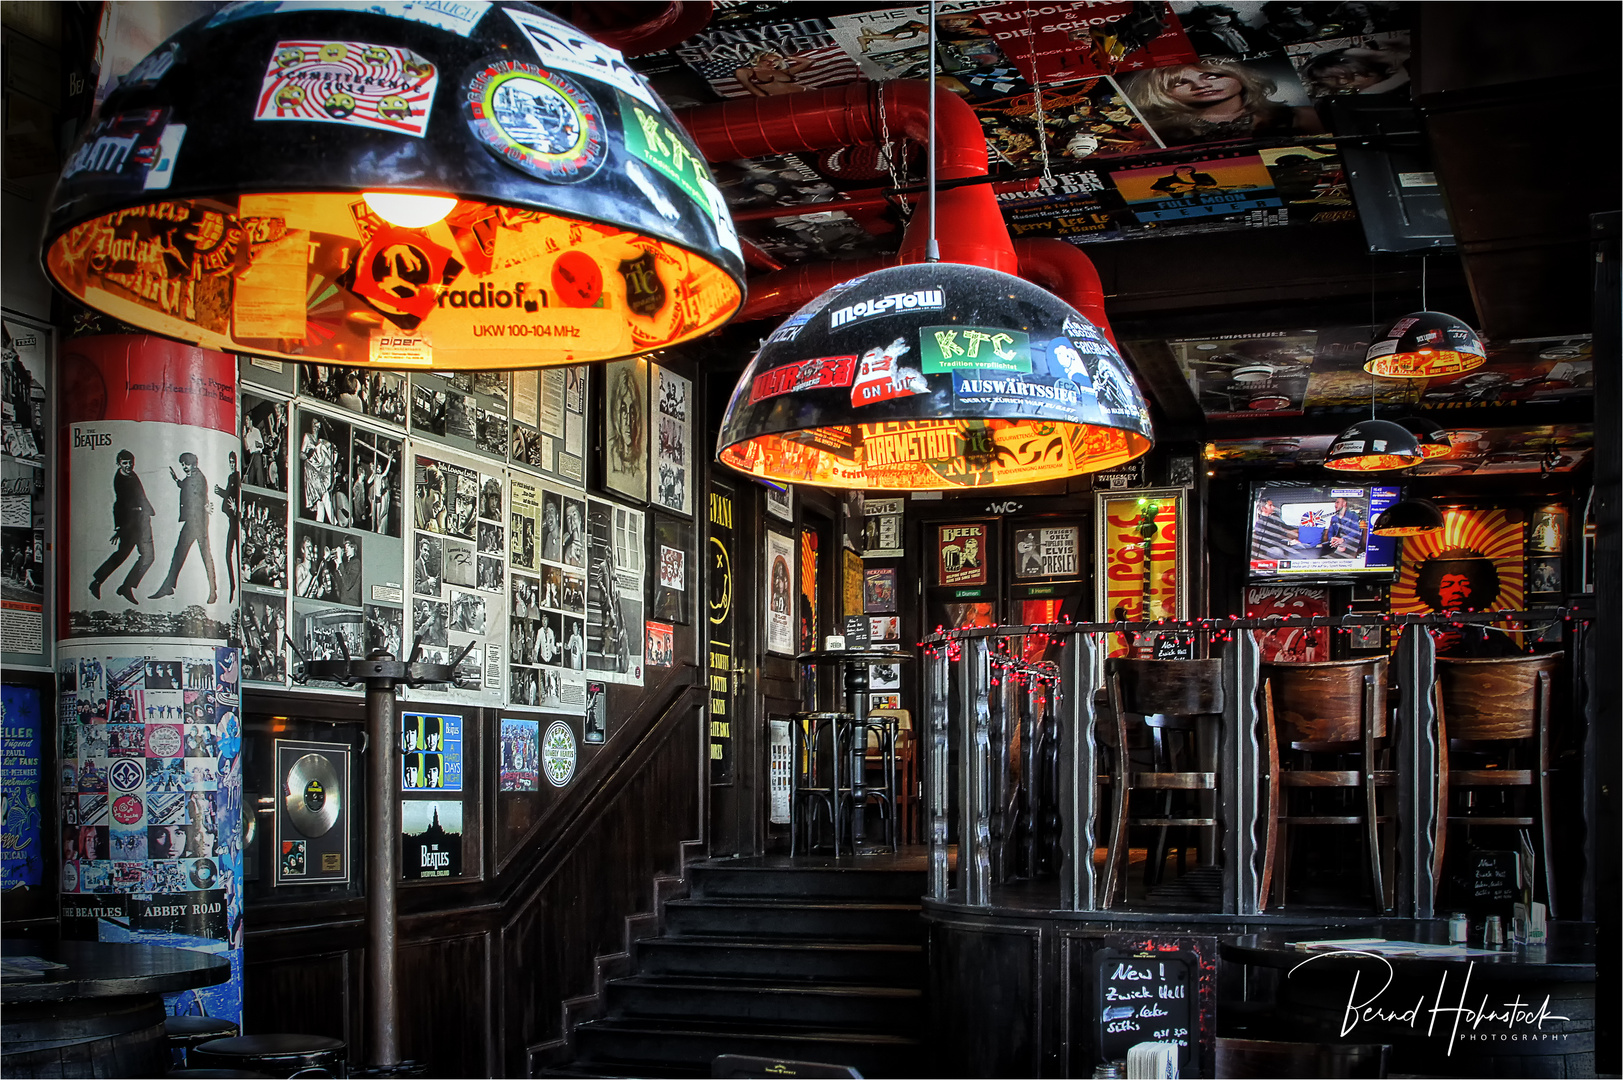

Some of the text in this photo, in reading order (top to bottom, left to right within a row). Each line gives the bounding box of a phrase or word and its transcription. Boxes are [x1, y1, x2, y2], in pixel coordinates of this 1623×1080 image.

[851, 1, 994, 23] THE CARS
[995, 13, 1127, 40] DIE SCHOC
[1061, 181, 1105, 194] DEN
[1158, 193, 1246, 210] FULL MOON
[1012, 221, 1052, 235] Jerry
[1058, 215, 1087, 228] Lee
[204, 228, 242, 270] LEIPZIG
[473, 325, 581, 338] UKW 100-104 MHz
[380, 338, 422, 347] piper
[934, 329, 1017, 361] KTC
[975, 361, 1017, 370] verpflichtet
[126, 381, 160, 392] Lonely
[863, 385, 881, 398] ON
[960, 377, 1077, 404] AUSWÄRTSSIEG
[1420, 399, 1518, 411] NIRVANA
[74, 427, 112, 450] BEATLES
[864, 431, 960, 467] DARMSTADT
[1037, 462, 1063, 470] AMSTERDAM
[866, 503, 897, 515] ELVIS
[993, 502, 1016, 514] WC
[943, 528, 982, 542] BEER
[1046, 547, 1073, 555] ELVIS
[1042, 555, 1077, 574] PRESLEY
[19, 757, 39, 766] FANS
[444, 762, 460, 773] DAYS
[445, 773, 460, 783] NIGHT
[421, 844, 449, 870] BEATLES
[76, 907, 122, 917] BEATLES
[144, 904, 188, 917] ABBEY
[192, 903, 222, 916] ROAD
[1111, 963, 1152, 980] New
[1105, 984, 1185, 1001] Zwick Hell
